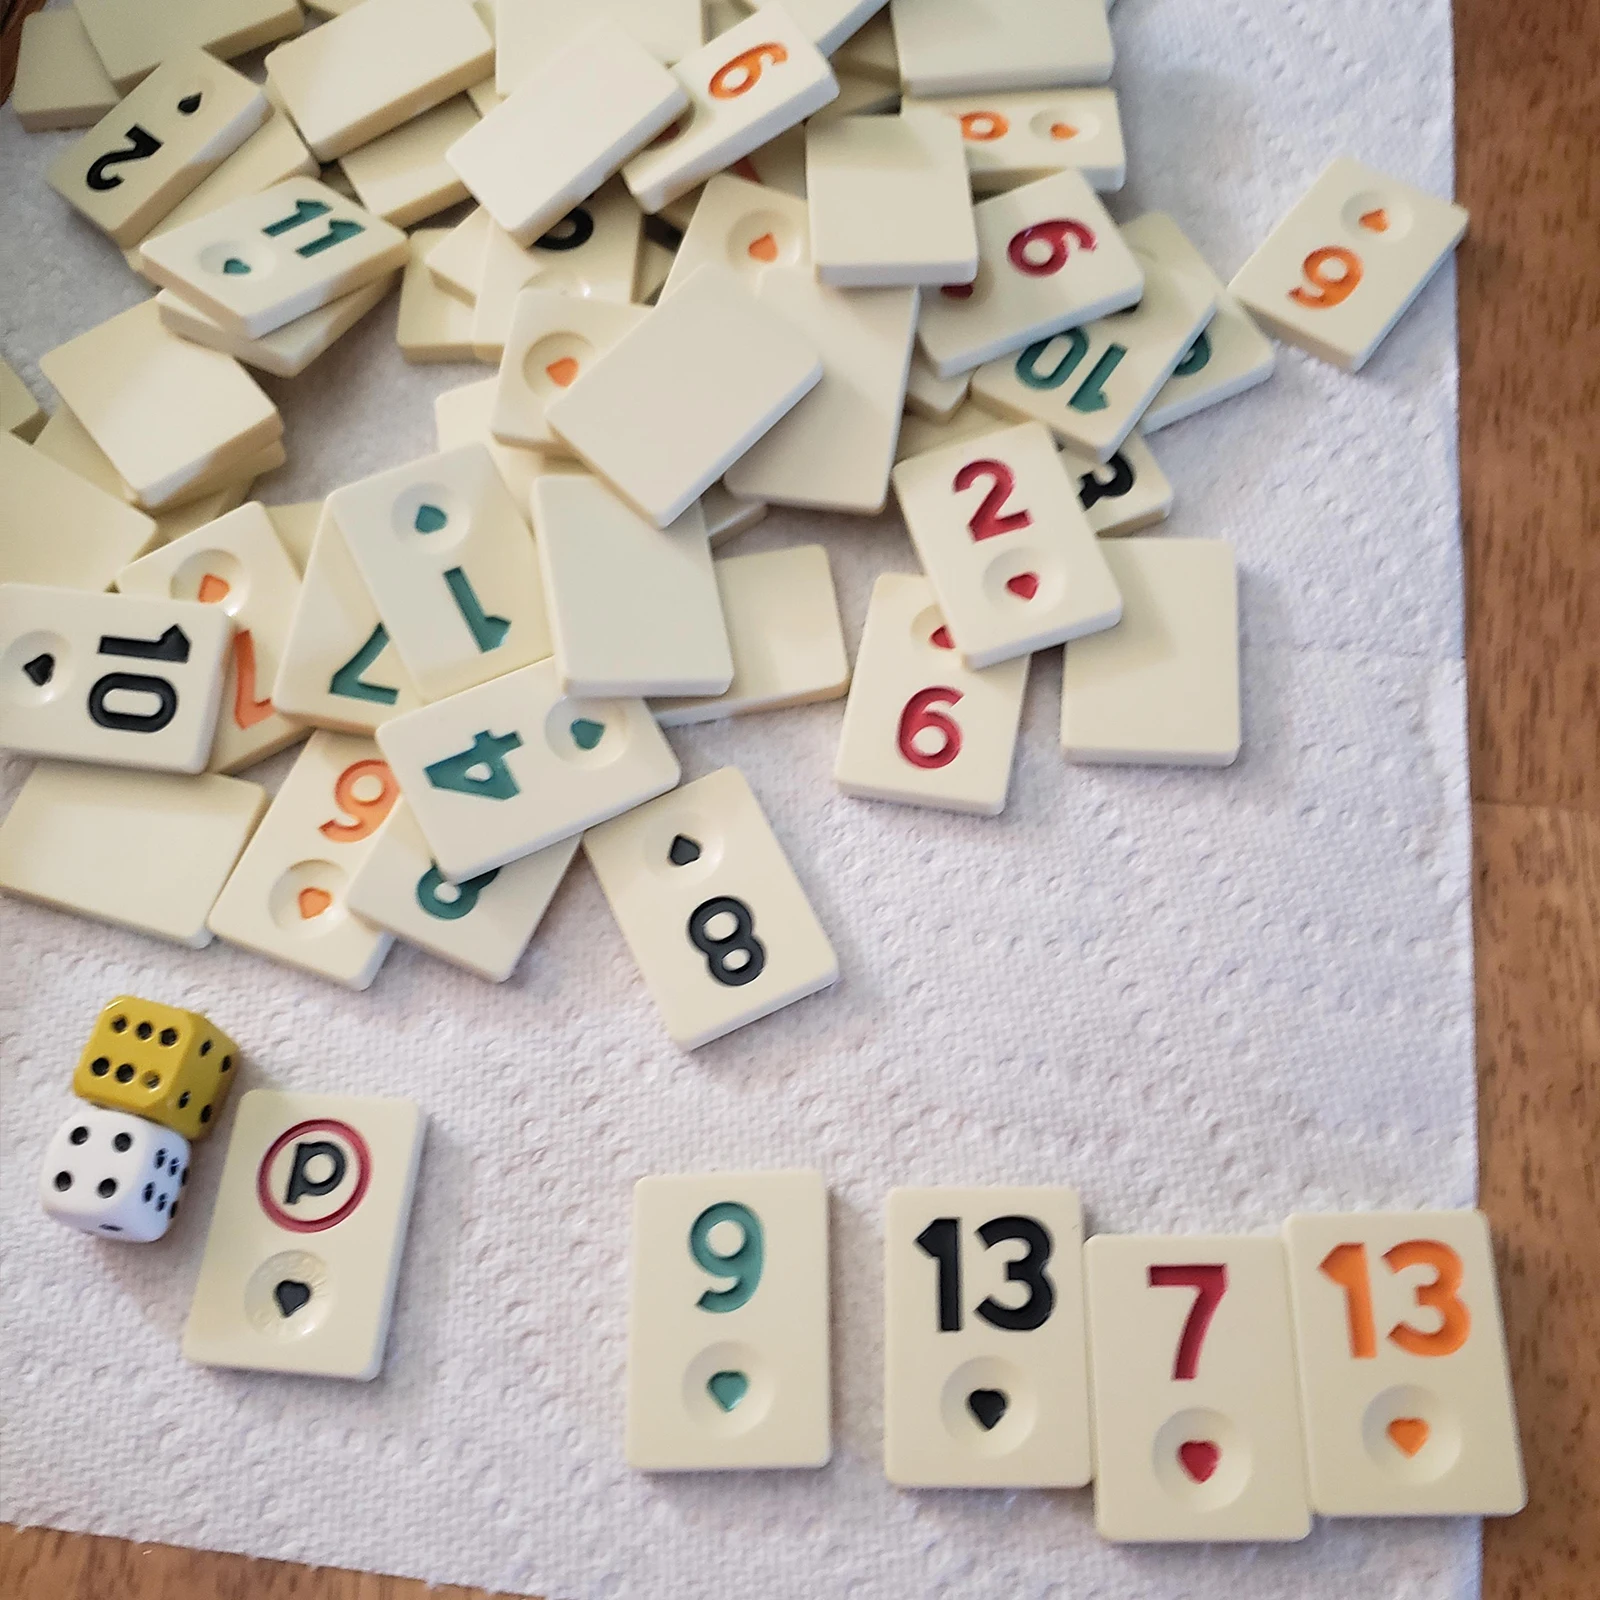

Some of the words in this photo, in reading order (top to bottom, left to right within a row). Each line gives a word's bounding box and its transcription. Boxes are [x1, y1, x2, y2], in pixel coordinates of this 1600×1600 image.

[86, 124, 163, 191] 2
[261, 199, 366, 259] 11
[1014, 326, 1128, 413] 10
[952, 458, 1034, 543] 2
[442, 566, 512, 653] 1
[87, 623, 191, 734] 10
[422, 729, 526, 801] 4
[688, 895, 766, 987] 8
[688, 1201, 766, 1314] 9
[914, 1215, 1056, 1333] 13
[1317, 1239, 1471, 1360] 13
[1147, 1263, 1230, 1382] 7
